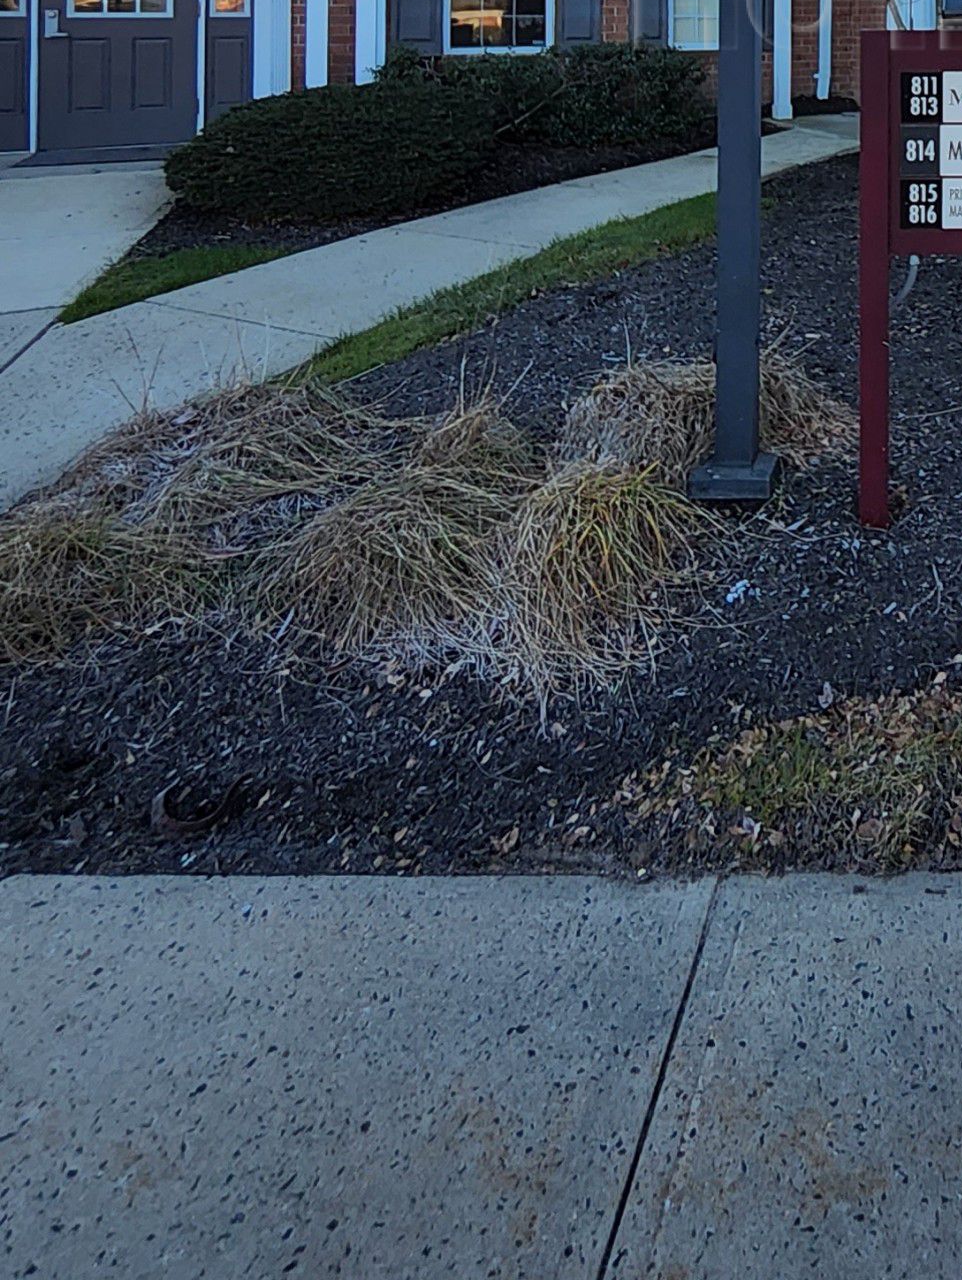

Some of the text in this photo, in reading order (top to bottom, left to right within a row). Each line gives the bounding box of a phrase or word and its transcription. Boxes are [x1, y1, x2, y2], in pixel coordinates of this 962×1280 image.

[911, 76, 938, 96] 811
[910, 97, 939, 117] 813
[905, 140, 936, 162] 814
[908, 184, 938, 203] 815
[908, 205, 938, 224] 816
